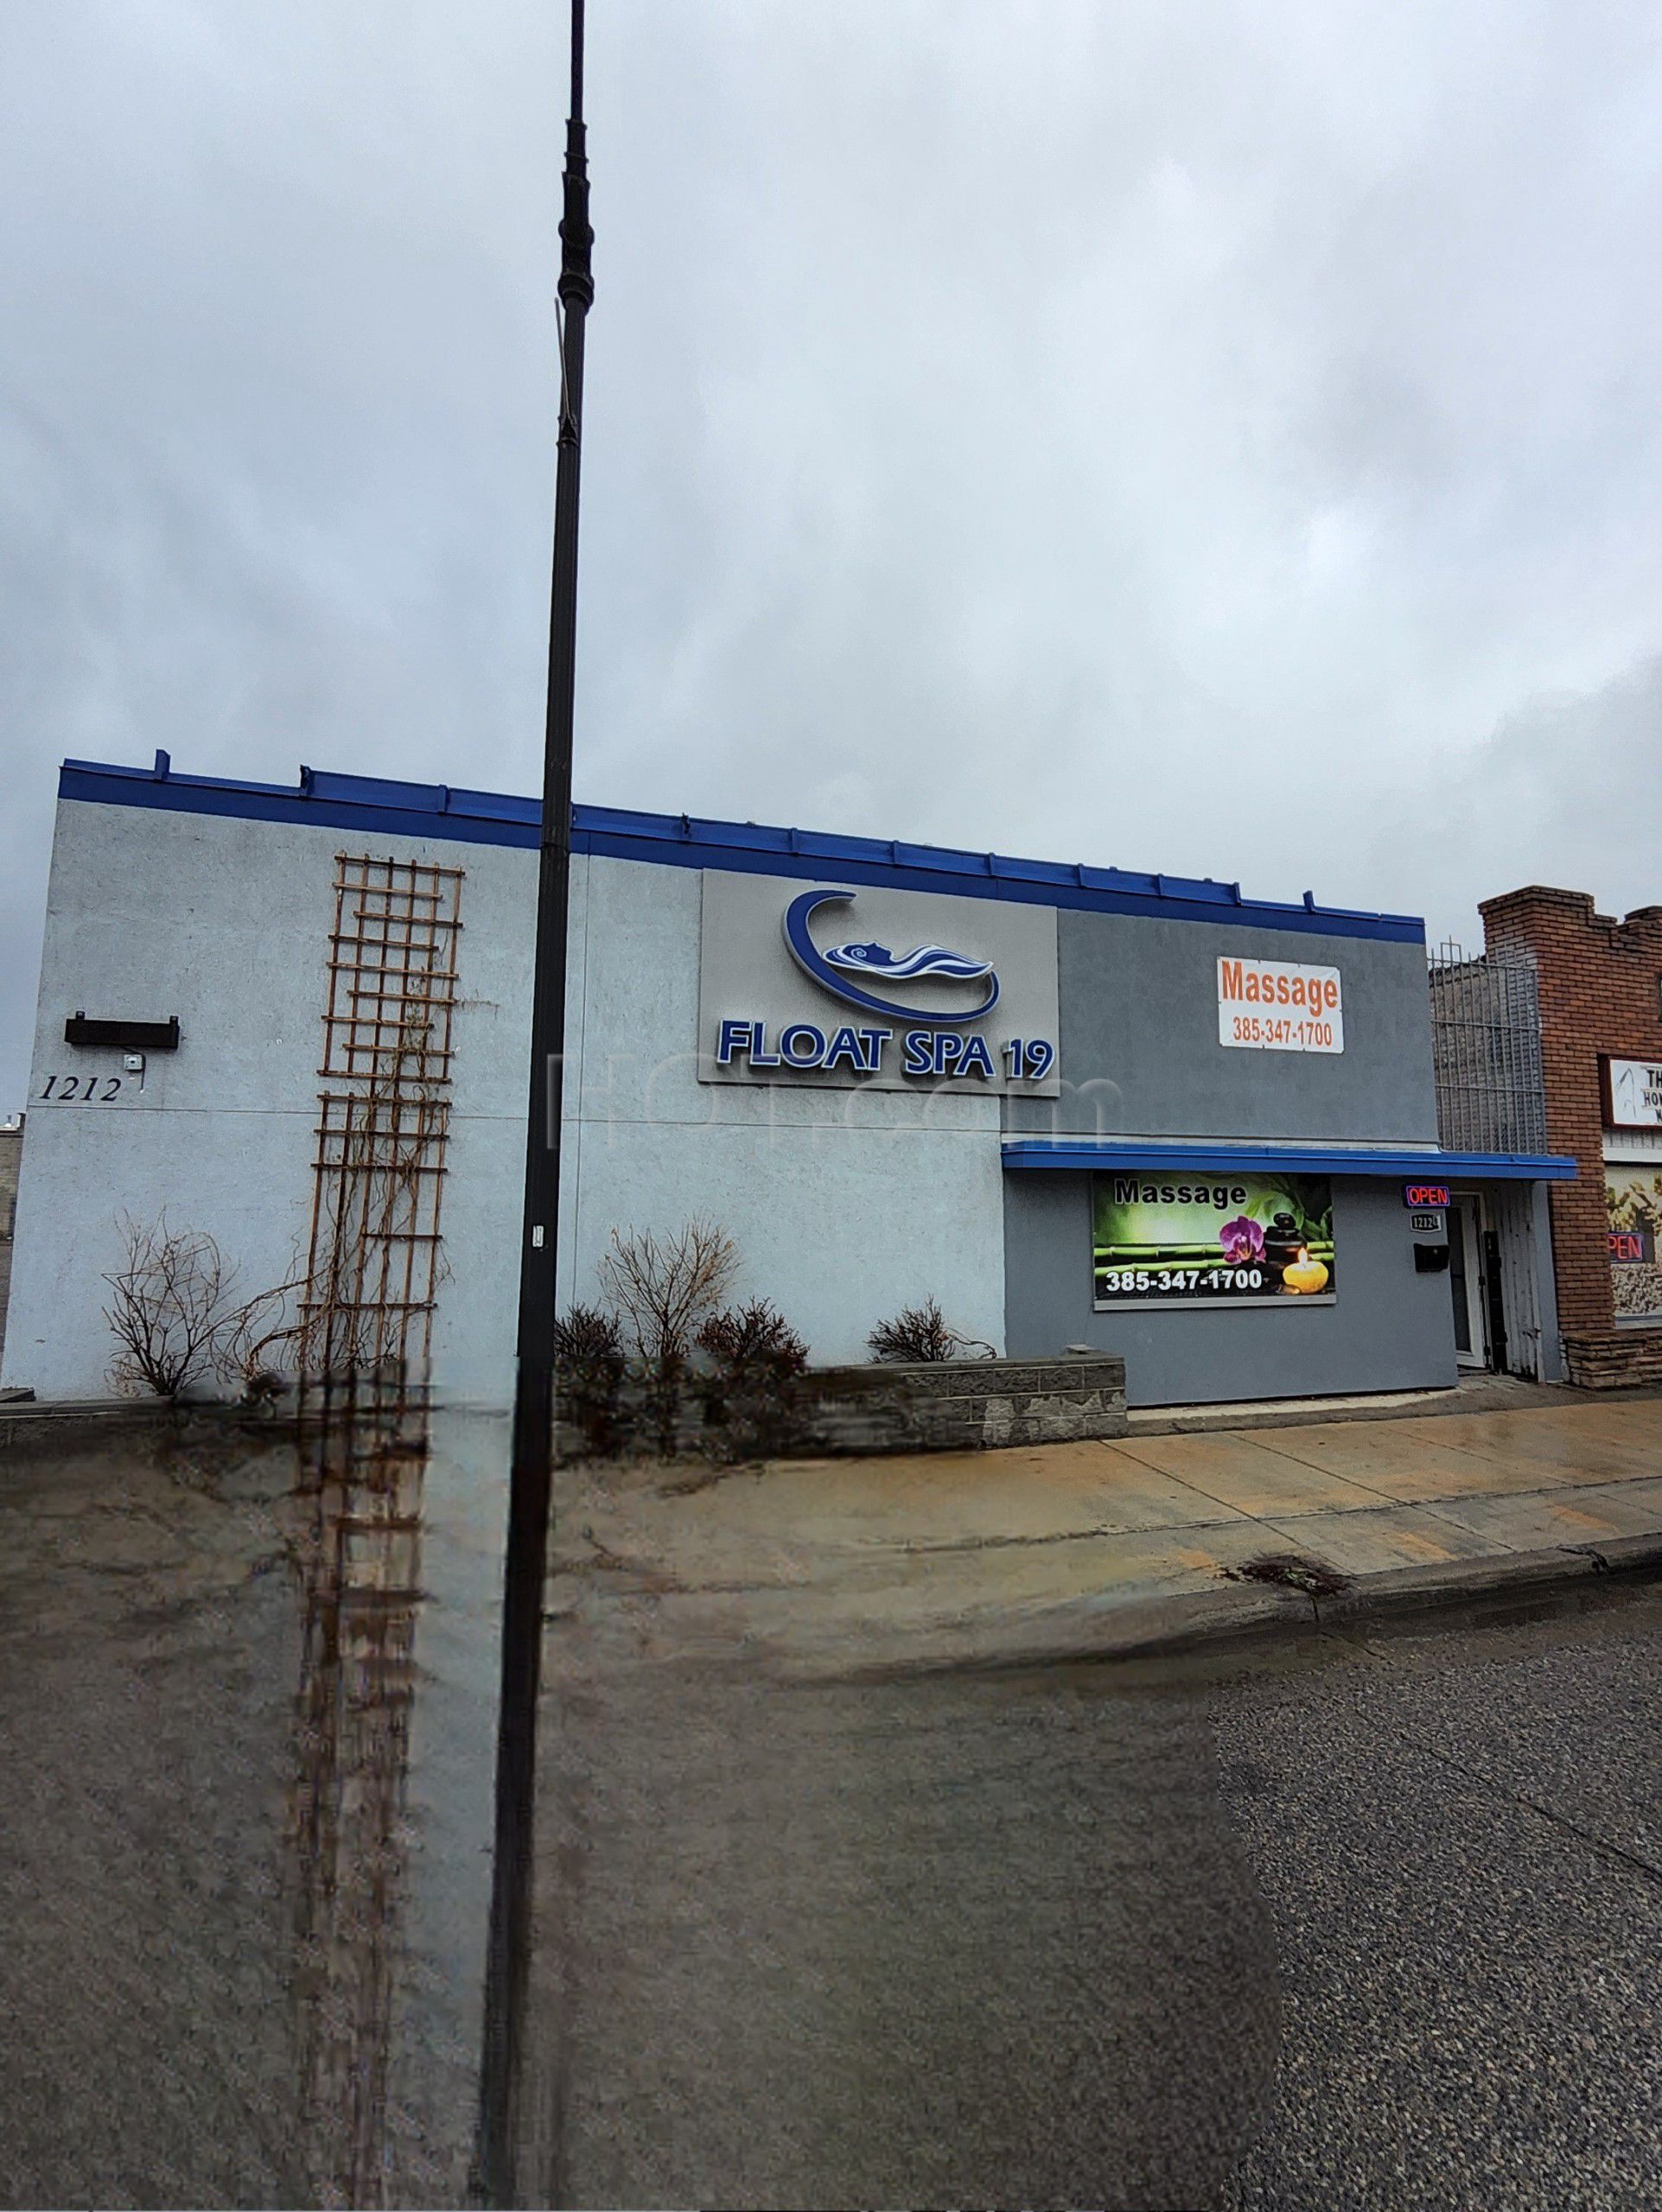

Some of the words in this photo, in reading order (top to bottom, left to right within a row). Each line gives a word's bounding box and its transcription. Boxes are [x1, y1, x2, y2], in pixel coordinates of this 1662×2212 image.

[1222, 960, 1338, 1017] Massage
[1233, 1016, 1332, 1046] 385-347-1700
[716, 1019, 893, 1071] FLOAT
[905, 1030, 997, 1077] SPA
[1003, 1038, 1055, 1080] 19
[39, 1076, 121, 1102] 1212
[1115, 1179, 1247, 1210] Massage
[1409, 1187, 1449, 1205] OPEN
[1105, 1269, 1263, 1292] 385-347-1700
